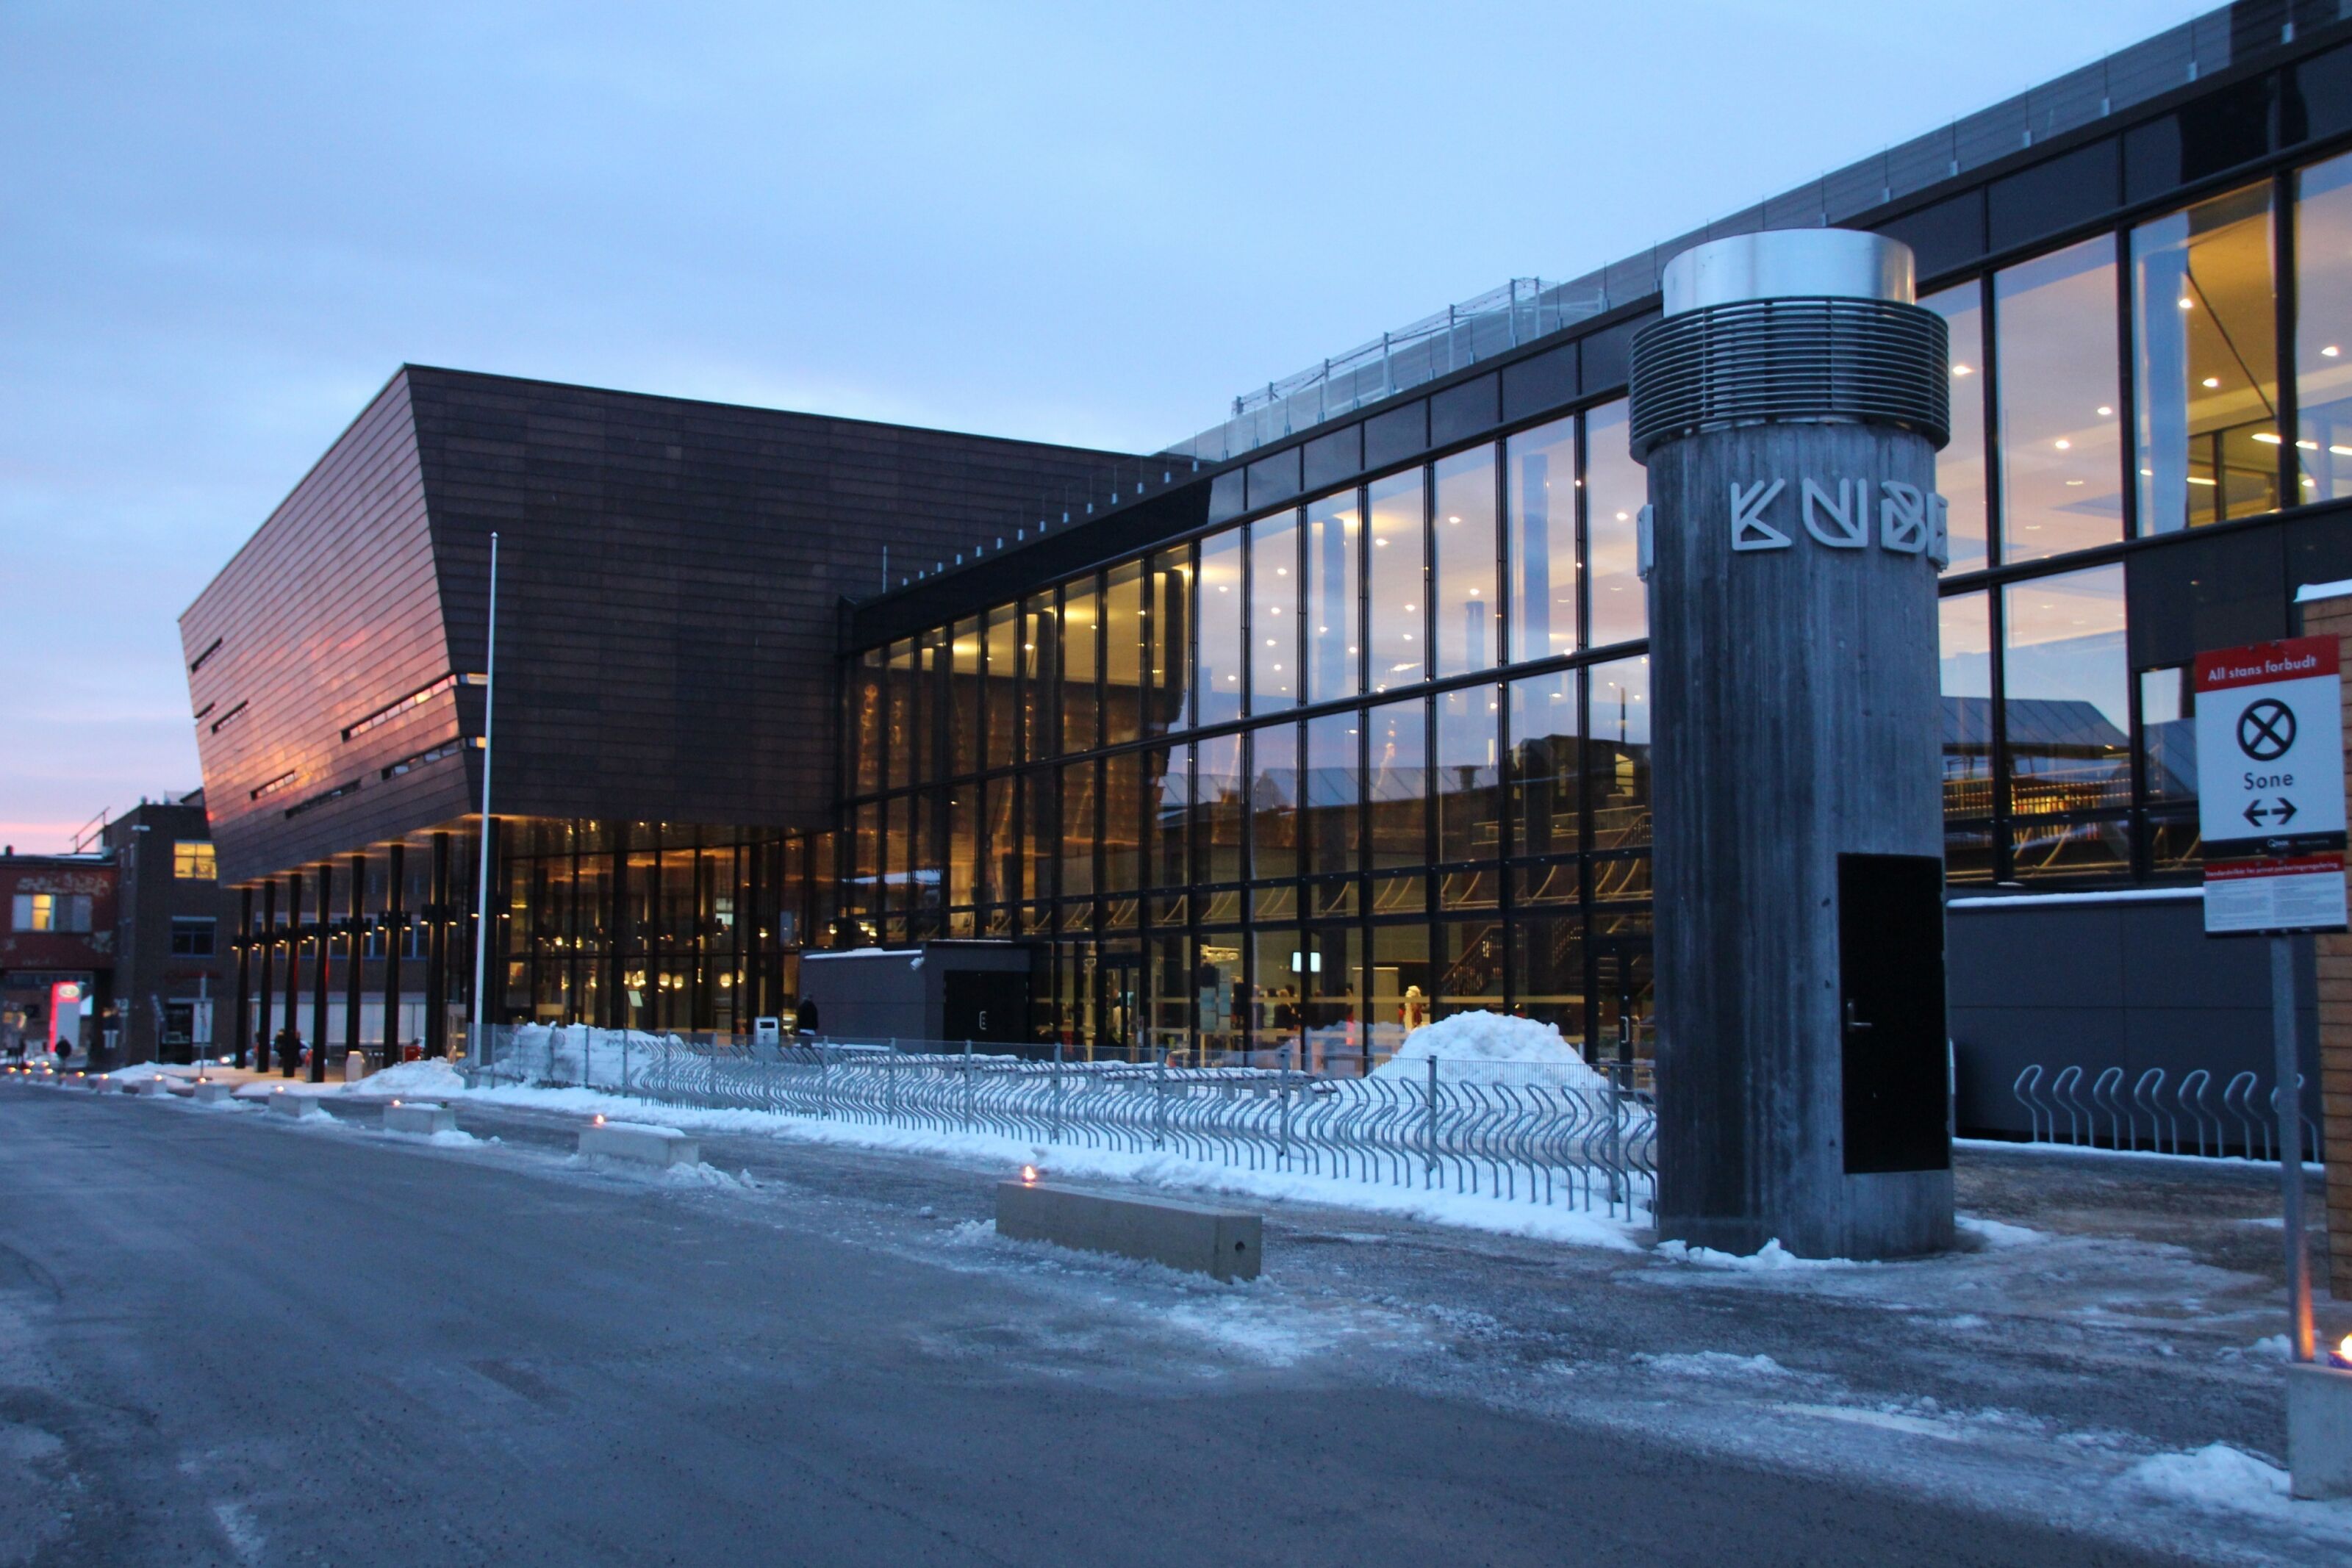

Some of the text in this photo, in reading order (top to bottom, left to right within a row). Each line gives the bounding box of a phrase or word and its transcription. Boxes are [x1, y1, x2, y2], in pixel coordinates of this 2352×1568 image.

[2208, 655, 2316, 681] All stans forbudt
[2244, 772, 2293, 790] Sone
